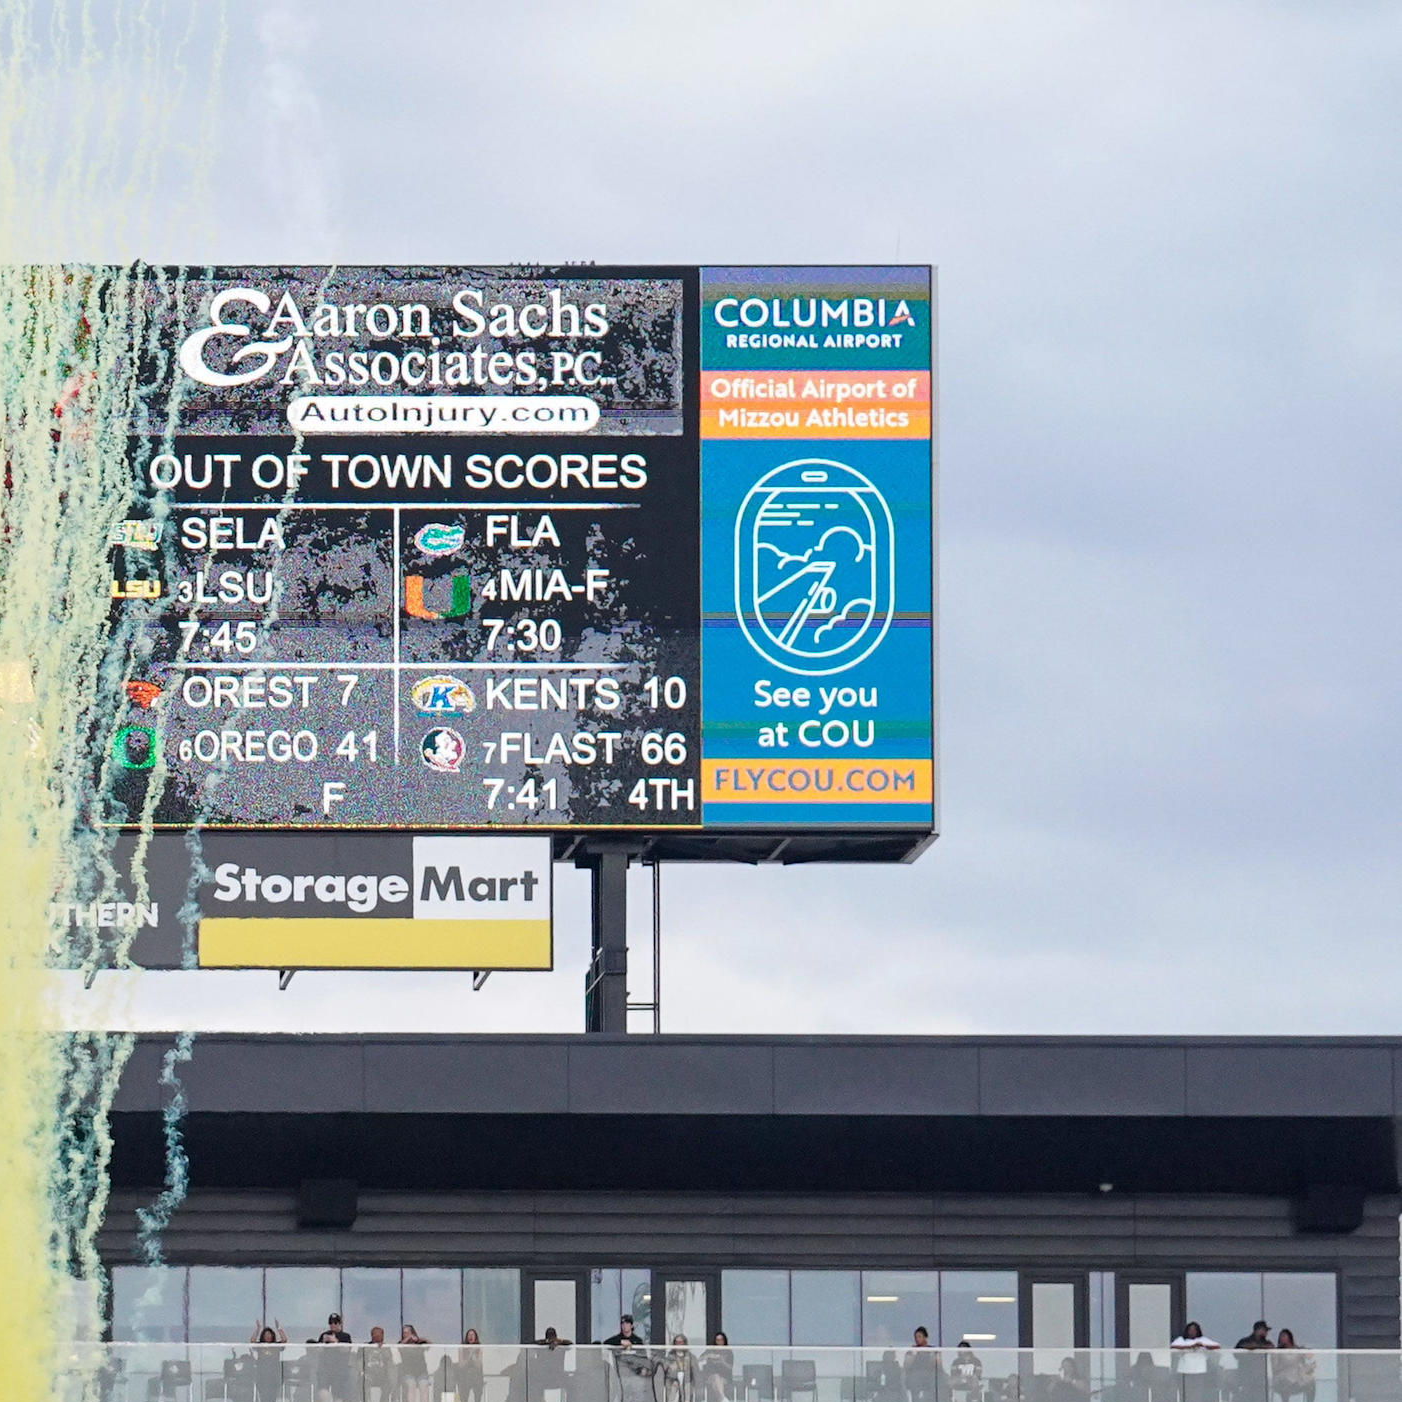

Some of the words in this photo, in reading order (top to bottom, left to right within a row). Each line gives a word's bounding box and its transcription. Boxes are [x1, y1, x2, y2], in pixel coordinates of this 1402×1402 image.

[263, 289, 433, 338] Aaron
[453, 289, 608, 338] Sachs
[714, 298, 915, 327] COLUMBIA
[726, 334, 818, 348] REGIONAL
[823, 334, 902, 348] AIRPORT
[710, 378, 796, 398] Official
[802, 379, 886, 402] Airport
[892, 379, 917, 398] of
[301, 402, 589, 427] AutoInjury.com
[719, 409, 799, 427] Mizzou
[805, 409, 909, 428] Athletics
[150, 455, 240, 488] OUT
[252, 455, 308, 488] OF
[322, 455, 451, 488] TOWN
[465, 455, 648, 488] SCORES
[182, 517, 286, 549] SELA
[486, 515, 560, 547] FLA
[111, 580, 161, 598] LSU
[179, 621, 257, 652] 7:45
[483, 619, 562, 651] 7:30
[183, 676, 318, 708] OREST
[338, 675, 358, 707] 7
[486, 678, 620, 710] KENTS
[645, 676, 687, 709] 10
[754, 680, 810, 707] See
[819, 687, 877, 715] you
[336, 730, 377, 761] 41
[641, 733, 687, 765] 66
[758, 722, 789, 747] at
[798, 720, 874, 747] COU
[482, 778, 557, 810] 7:41
[628, 778, 694, 810] 4TH
[715, 769, 915, 791] FLYCOU.COM
[323, 783, 346, 814] F
